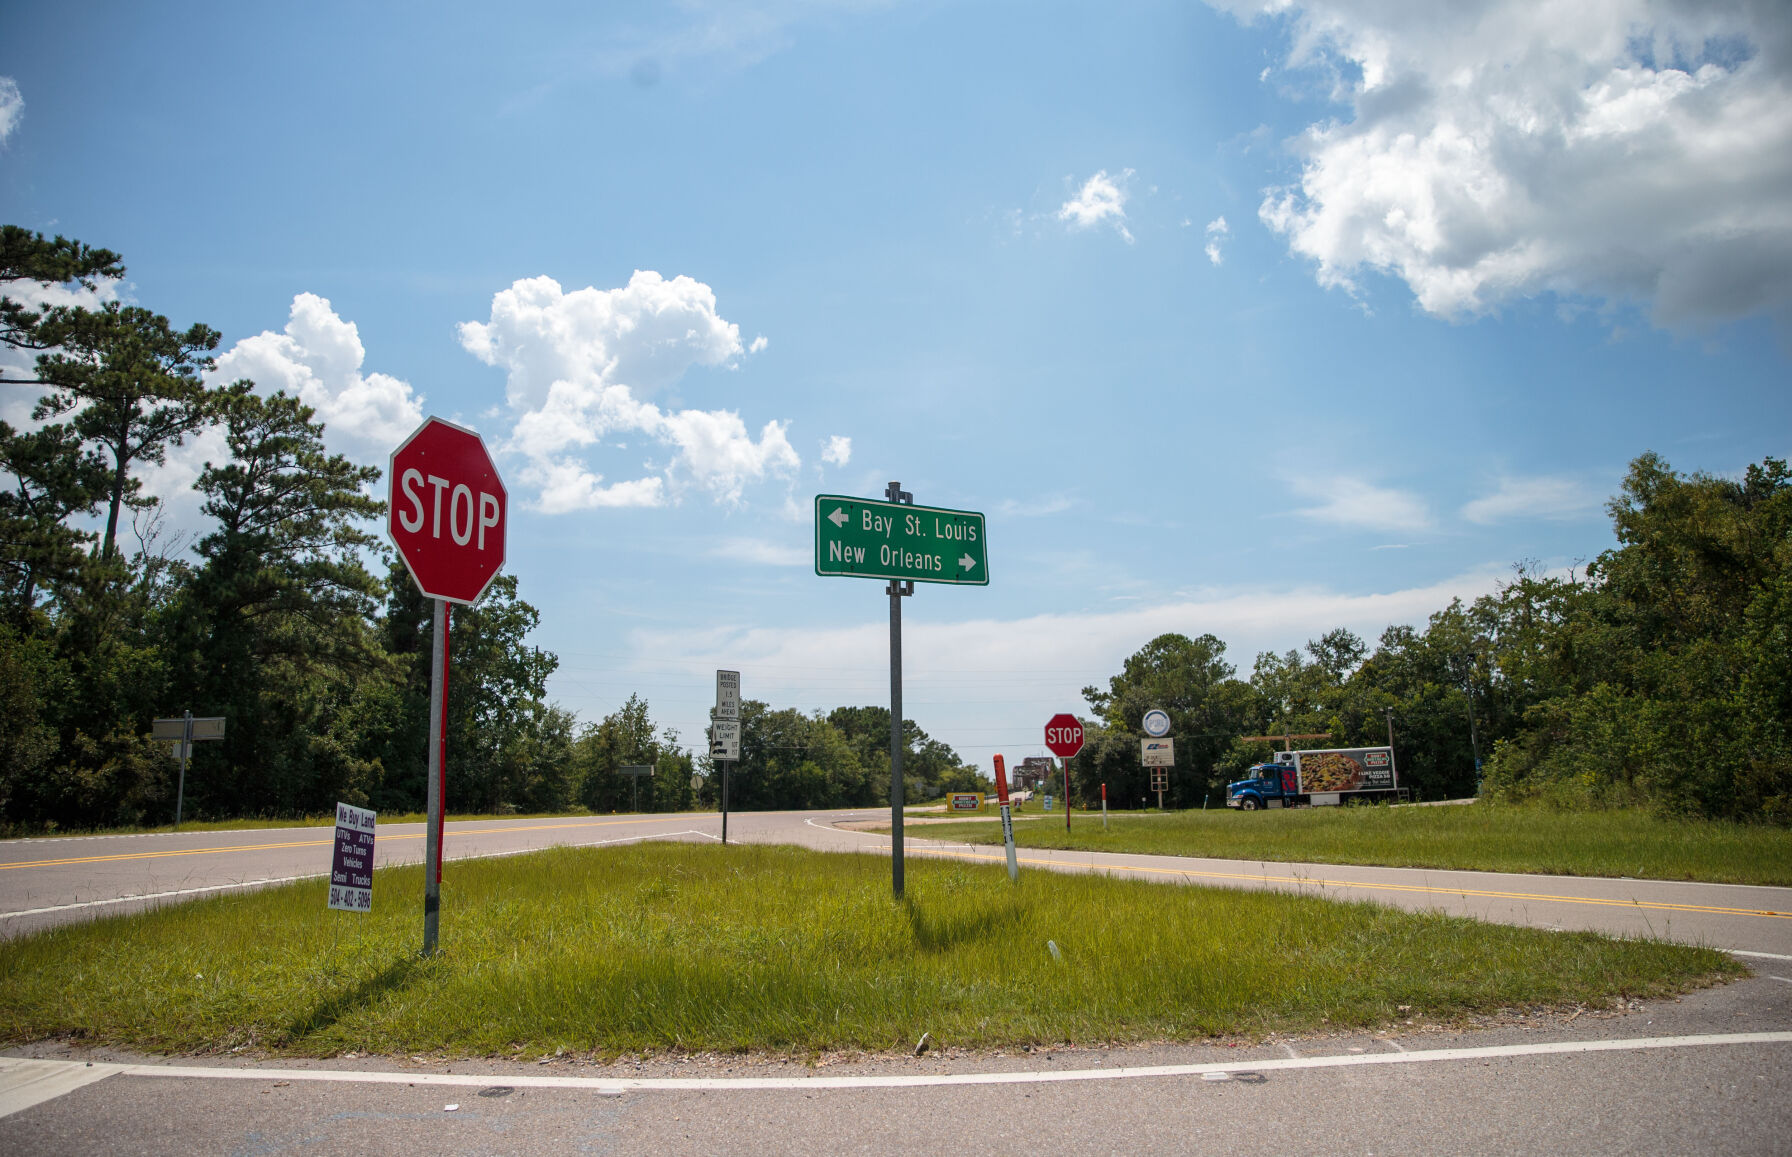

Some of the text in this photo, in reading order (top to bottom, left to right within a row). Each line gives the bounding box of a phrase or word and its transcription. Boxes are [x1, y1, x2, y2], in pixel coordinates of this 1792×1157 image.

[398, 468, 500, 550] STOP
[862, 509, 977, 542] Bay St. Louis
[829, 540, 942, 571] New Orleans
[1047, 727, 1082, 744] STOP
[339, 806, 375, 829] We Buy Land
[336, 829, 374, 845] UTVs ATVs
[341, 842, 367, 856] Zero Turns
[343, 856, 363, 869] Vehicles
[333, 870, 371, 887] Semi Trucks
